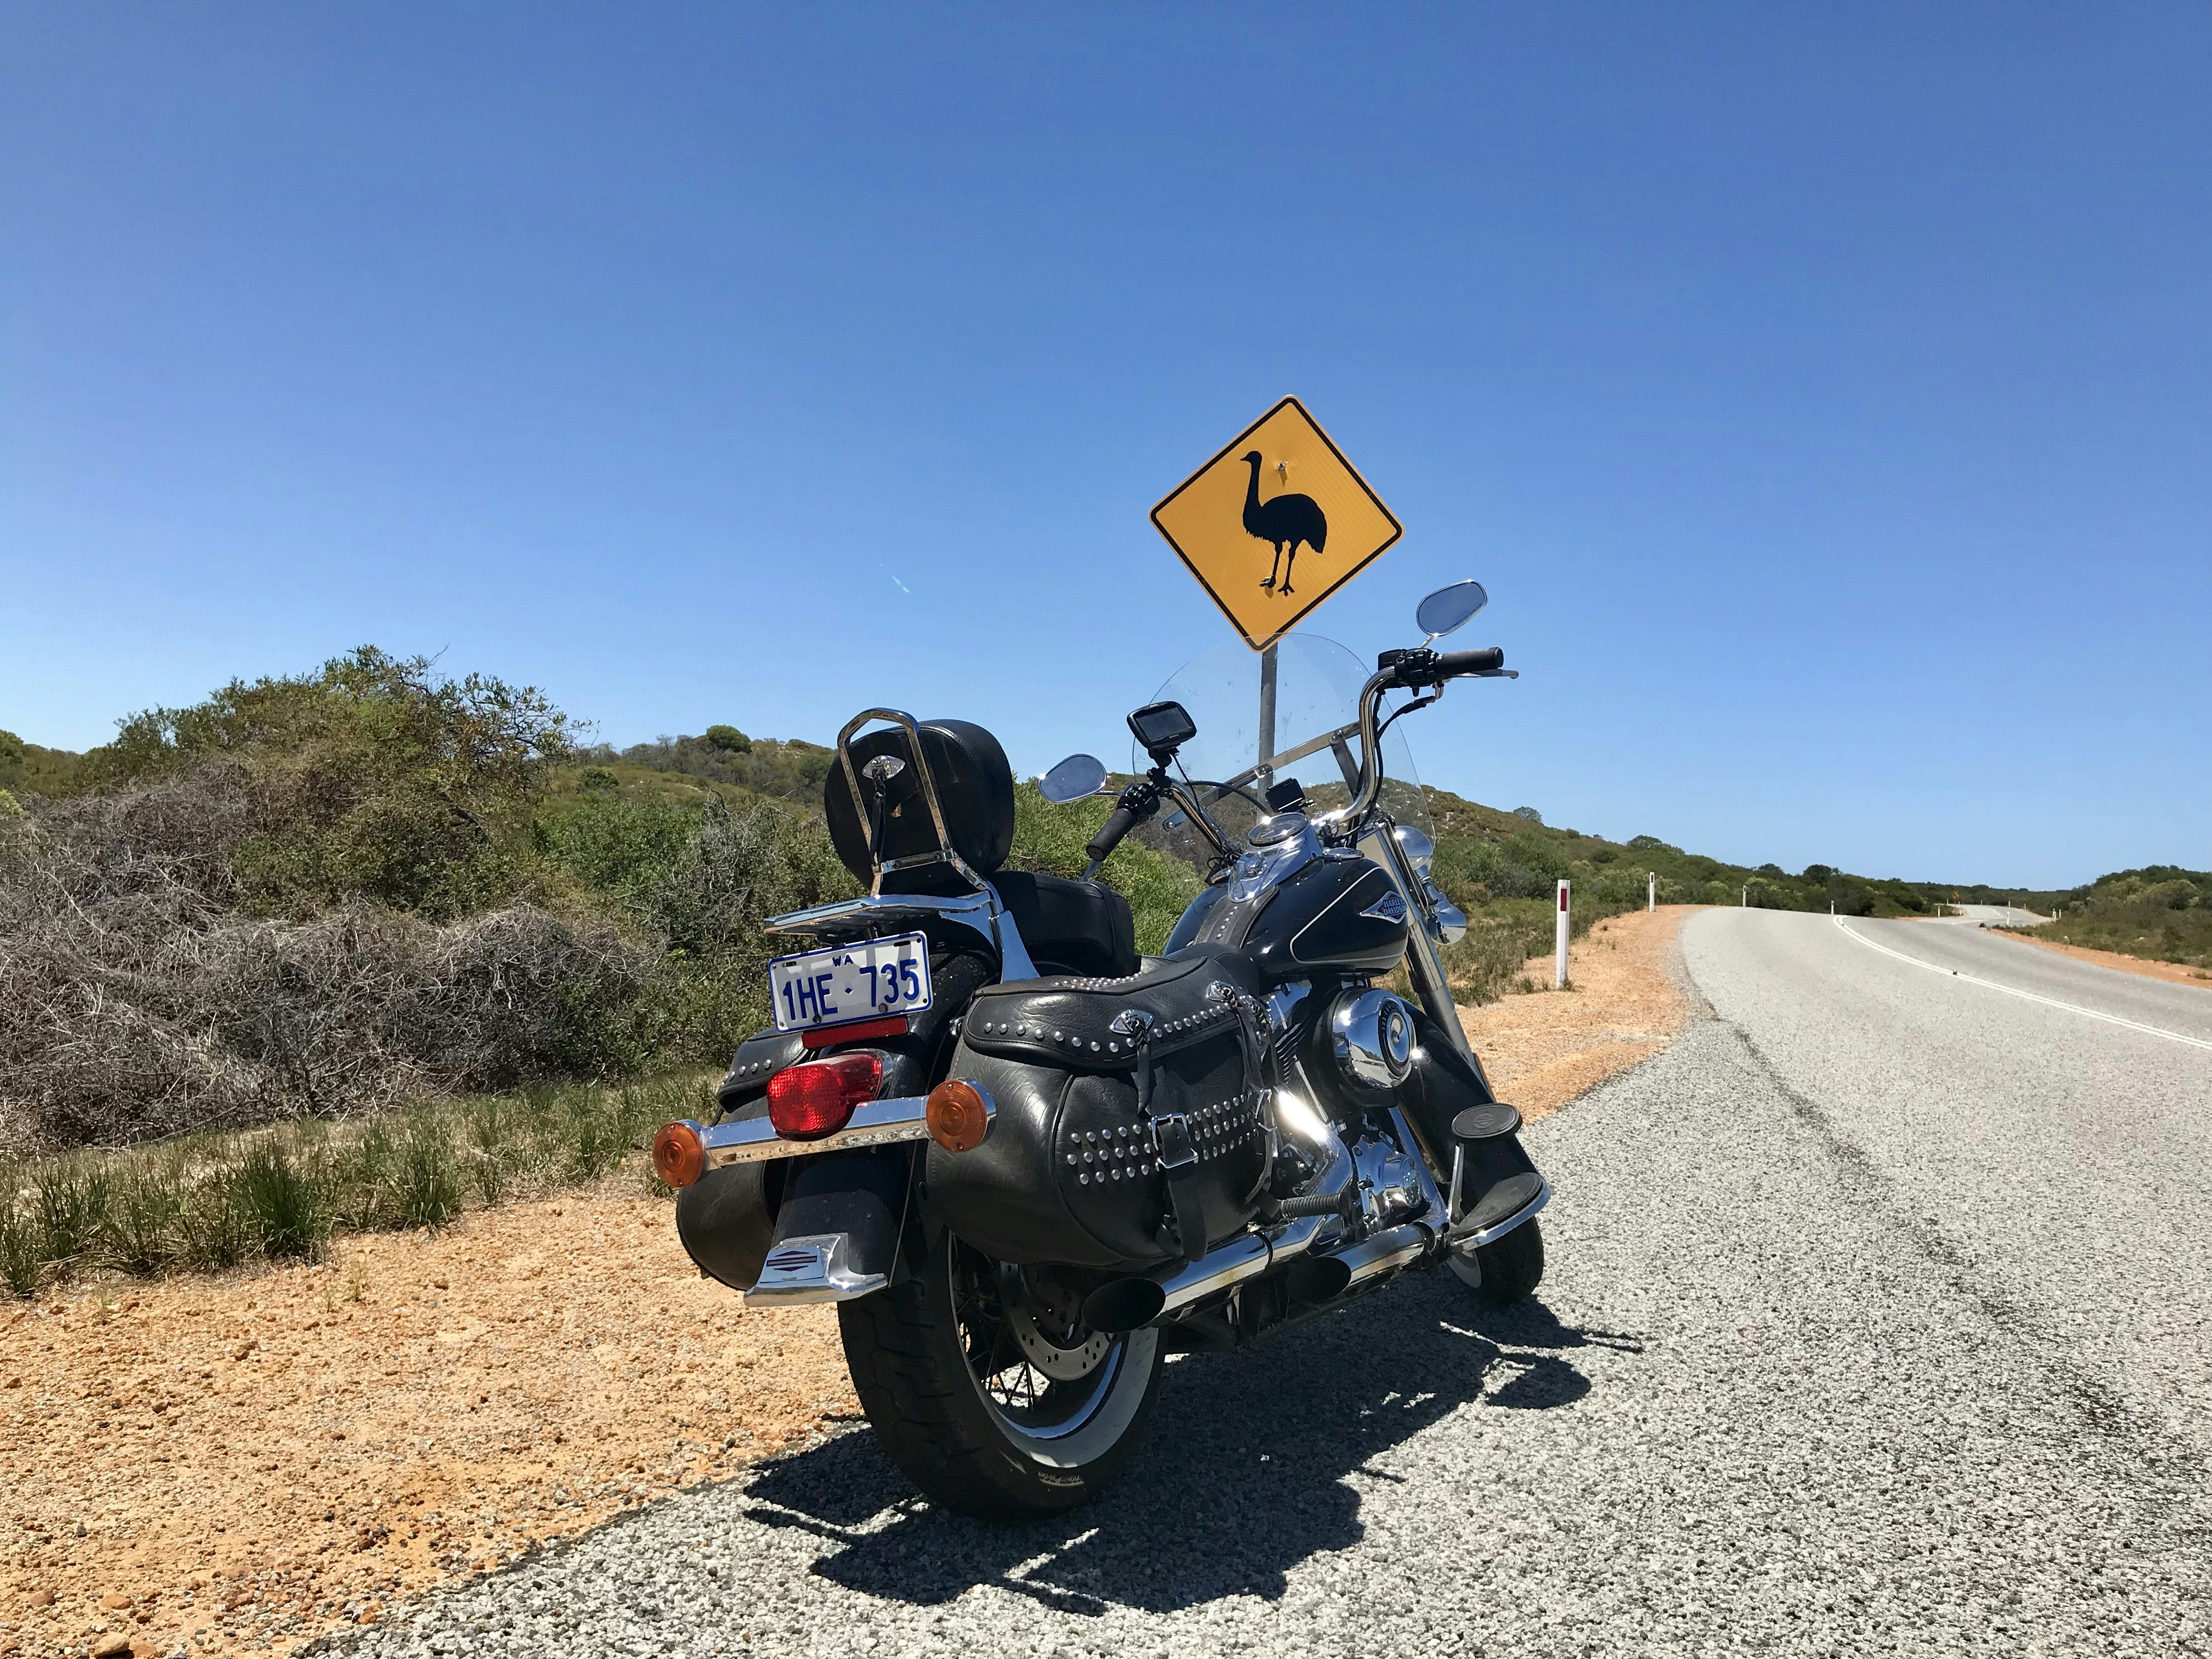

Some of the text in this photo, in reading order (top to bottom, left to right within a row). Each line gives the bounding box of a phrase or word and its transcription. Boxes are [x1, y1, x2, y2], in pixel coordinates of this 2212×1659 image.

[1383, 898, 1403, 908] HARLEY
[832, 955, 854, 967] WA
[859, 958, 919, 1007] 735
